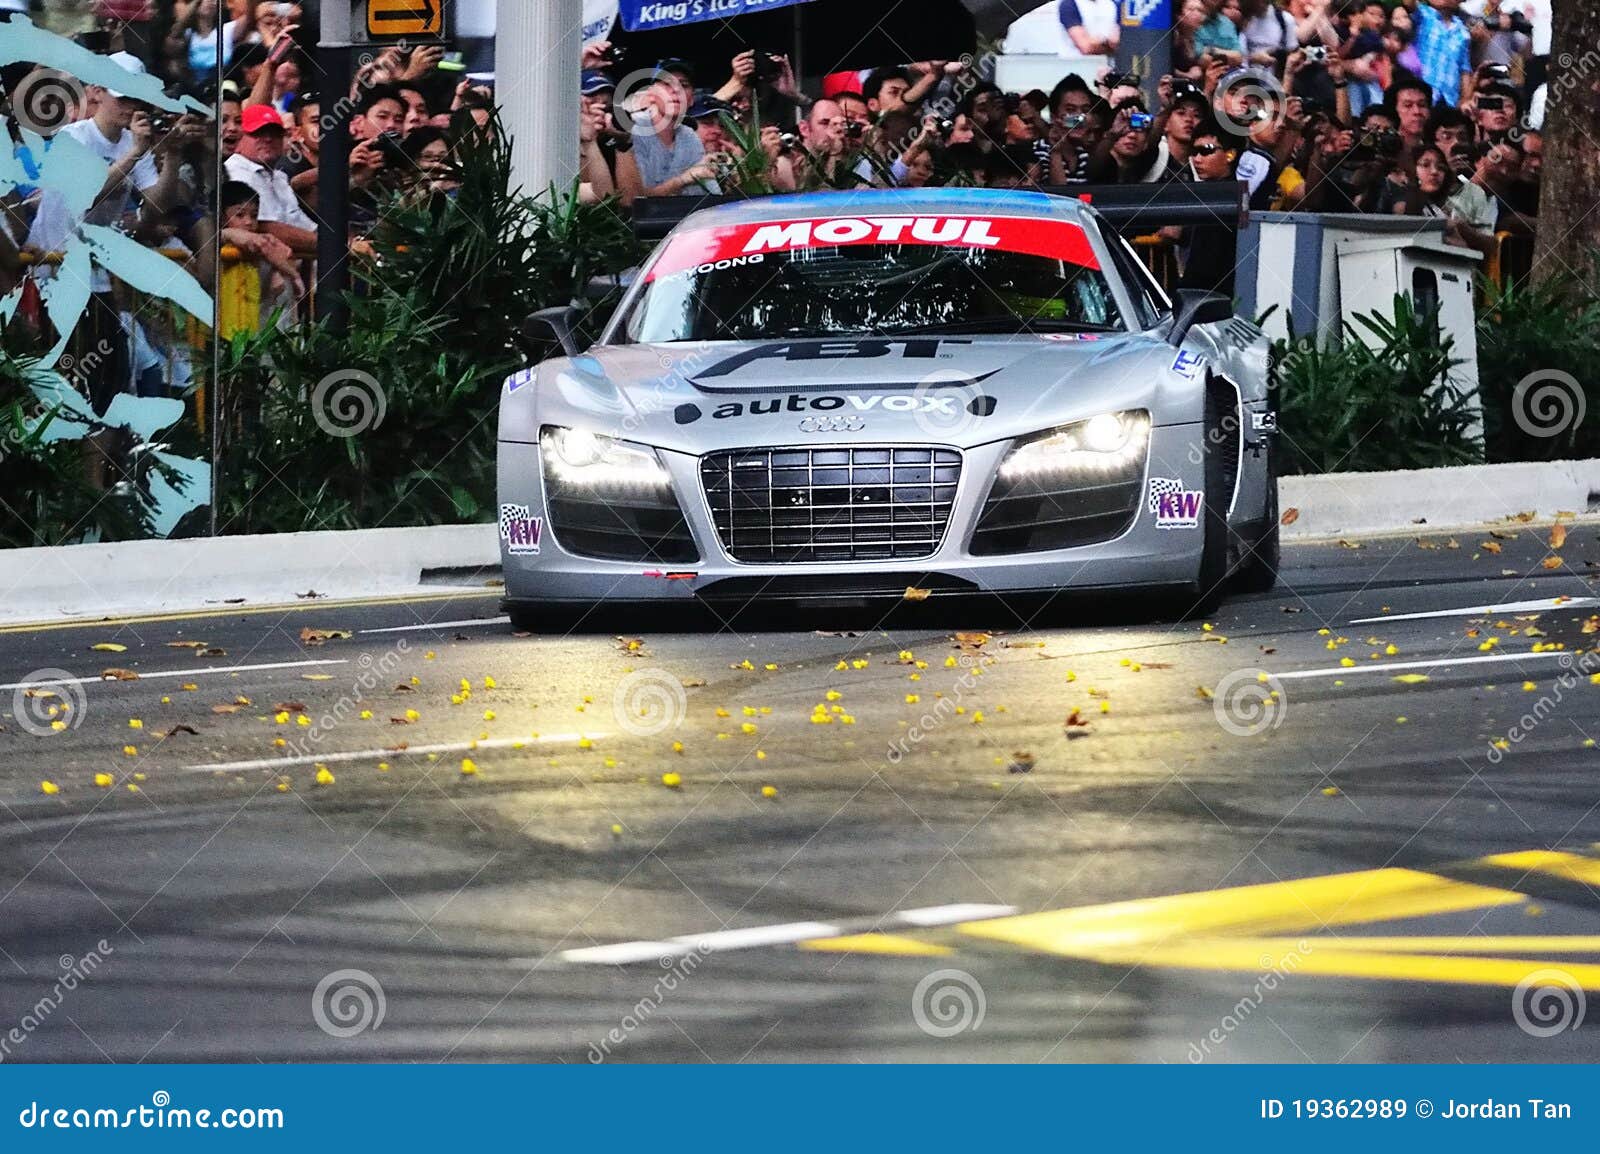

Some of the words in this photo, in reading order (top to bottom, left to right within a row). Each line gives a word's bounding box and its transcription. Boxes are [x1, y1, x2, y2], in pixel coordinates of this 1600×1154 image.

[640, 0, 703, 23] King's
[742, 217, 1000, 252] MOTUL
[691, 339, 972, 379] ABT
[712, 394, 955, 419] autovox
[1158, 492, 1200, 518] KW
[510, 518, 541, 545] KW
